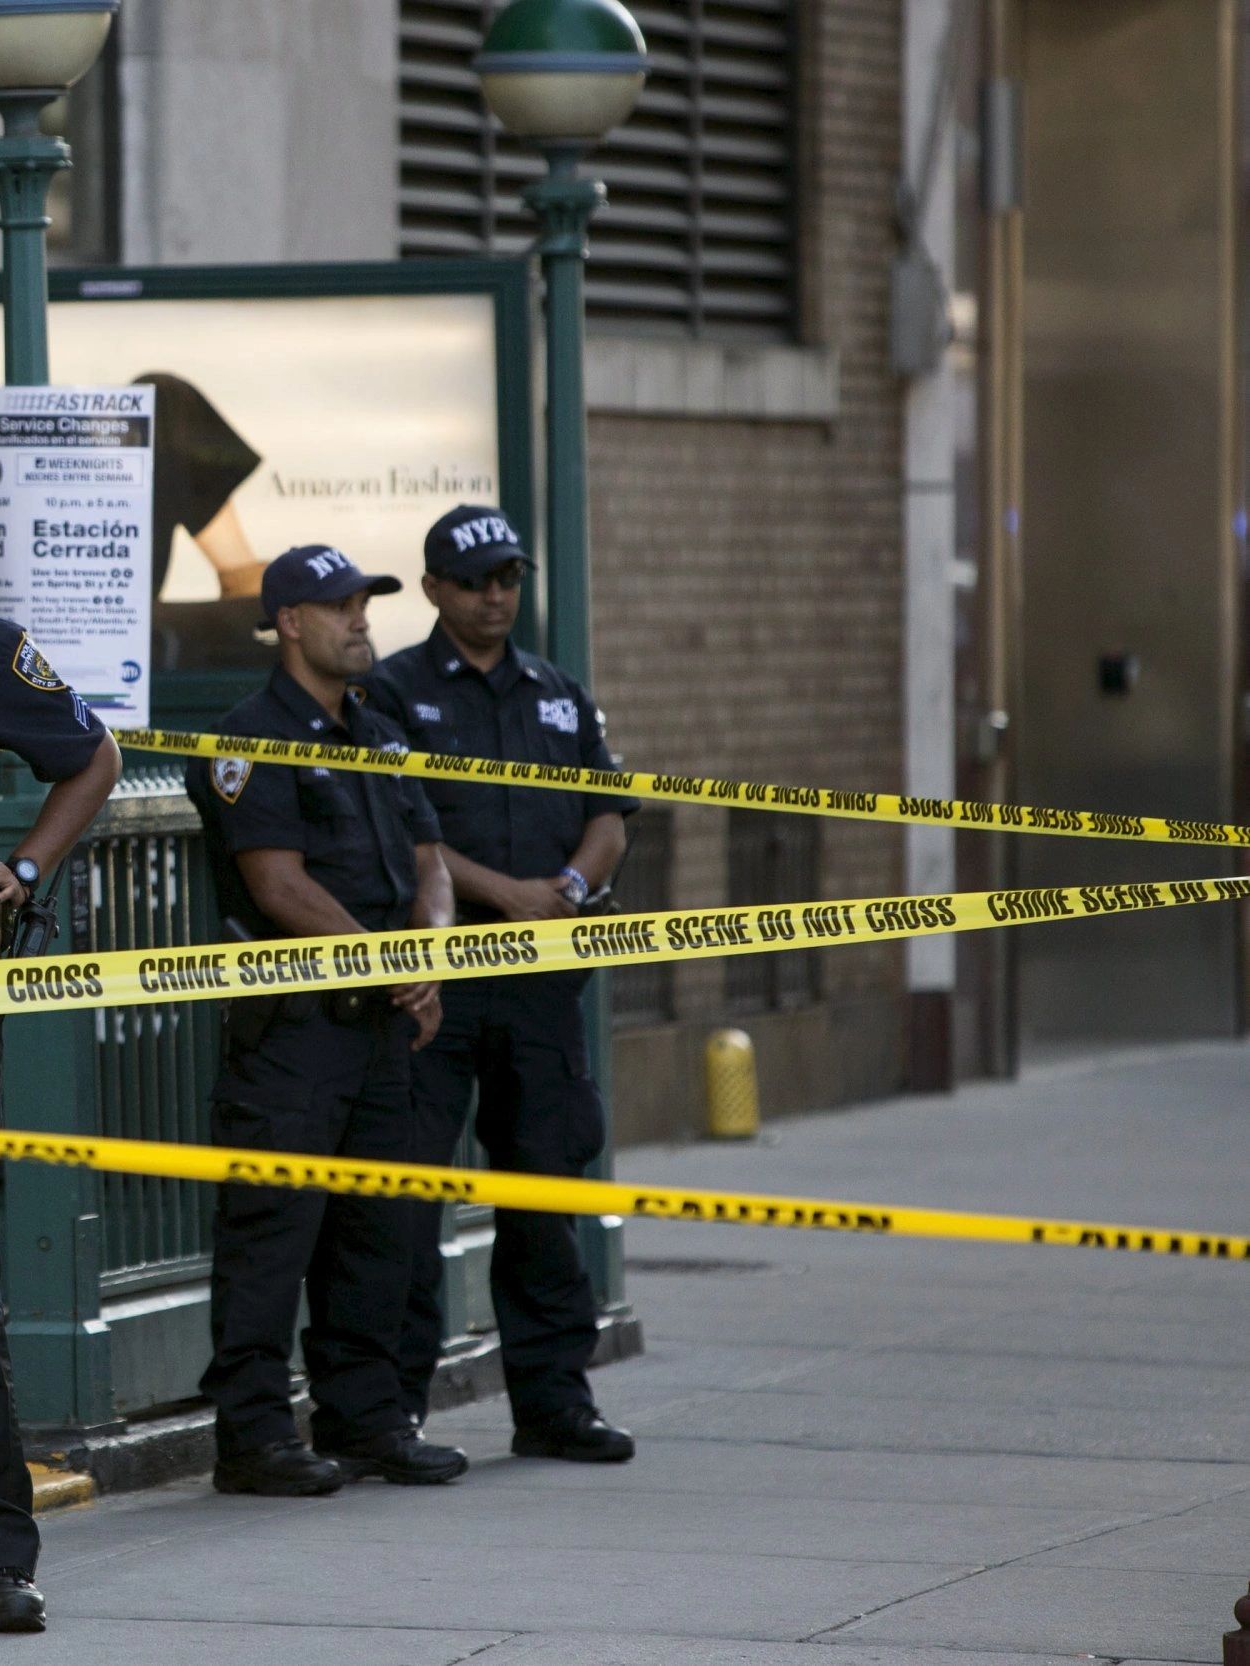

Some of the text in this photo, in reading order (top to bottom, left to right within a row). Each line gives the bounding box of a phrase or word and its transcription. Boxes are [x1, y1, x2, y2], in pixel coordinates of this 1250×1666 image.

[46, 394, 144, 411] FASTRACK
[1, 417, 55, 433] Service
[57, 417, 130, 434] Changes
[48, 457, 124, 470] WEEKNIGHTS
[271, 466, 493, 498] Amazon Fashion
[33, 517, 139, 538] Estación
[33, 540, 130, 558] Cerrada
[1027, 807, 1084, 831] SCENE
[987, 888, 1075, 922] CRIME
[1079, 884, 1166, 914] SCENE
[1169, 881, 1209, 904] DO
[571, 896, 958, 960] CRIME SCENE DO NOT CROSS
[138, 929, 539, 993] CRIME SCENE DO NOT CROSS
[6, 962, 104, 1003] CROSS
